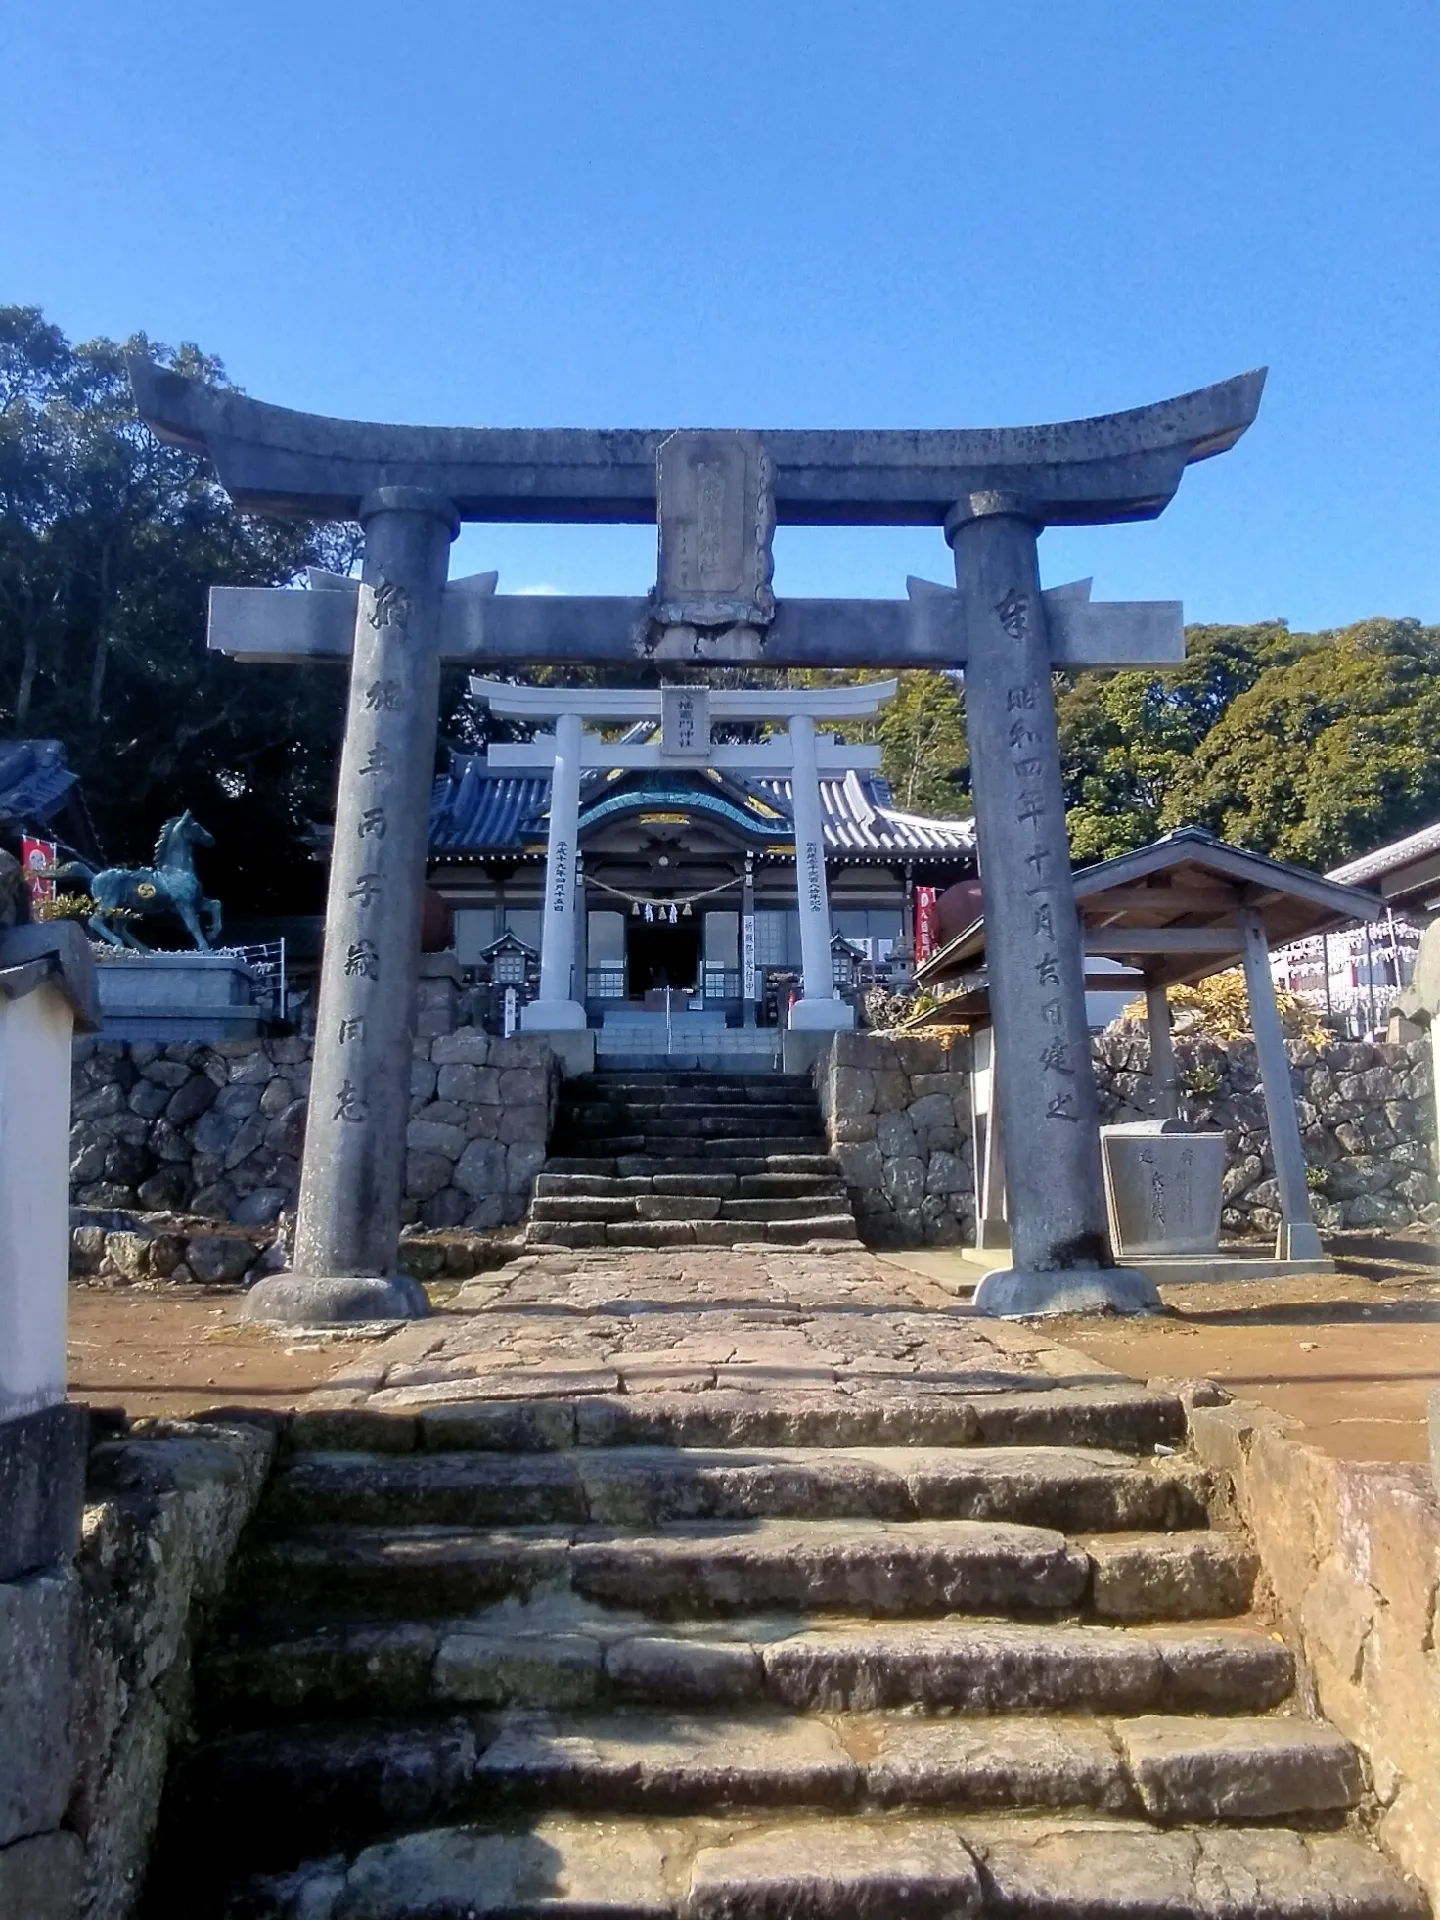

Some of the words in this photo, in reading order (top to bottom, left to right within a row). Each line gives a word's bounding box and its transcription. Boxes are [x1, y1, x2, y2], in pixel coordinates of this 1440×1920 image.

[553, 840, 568, 912] 平成十九年四月十五日
